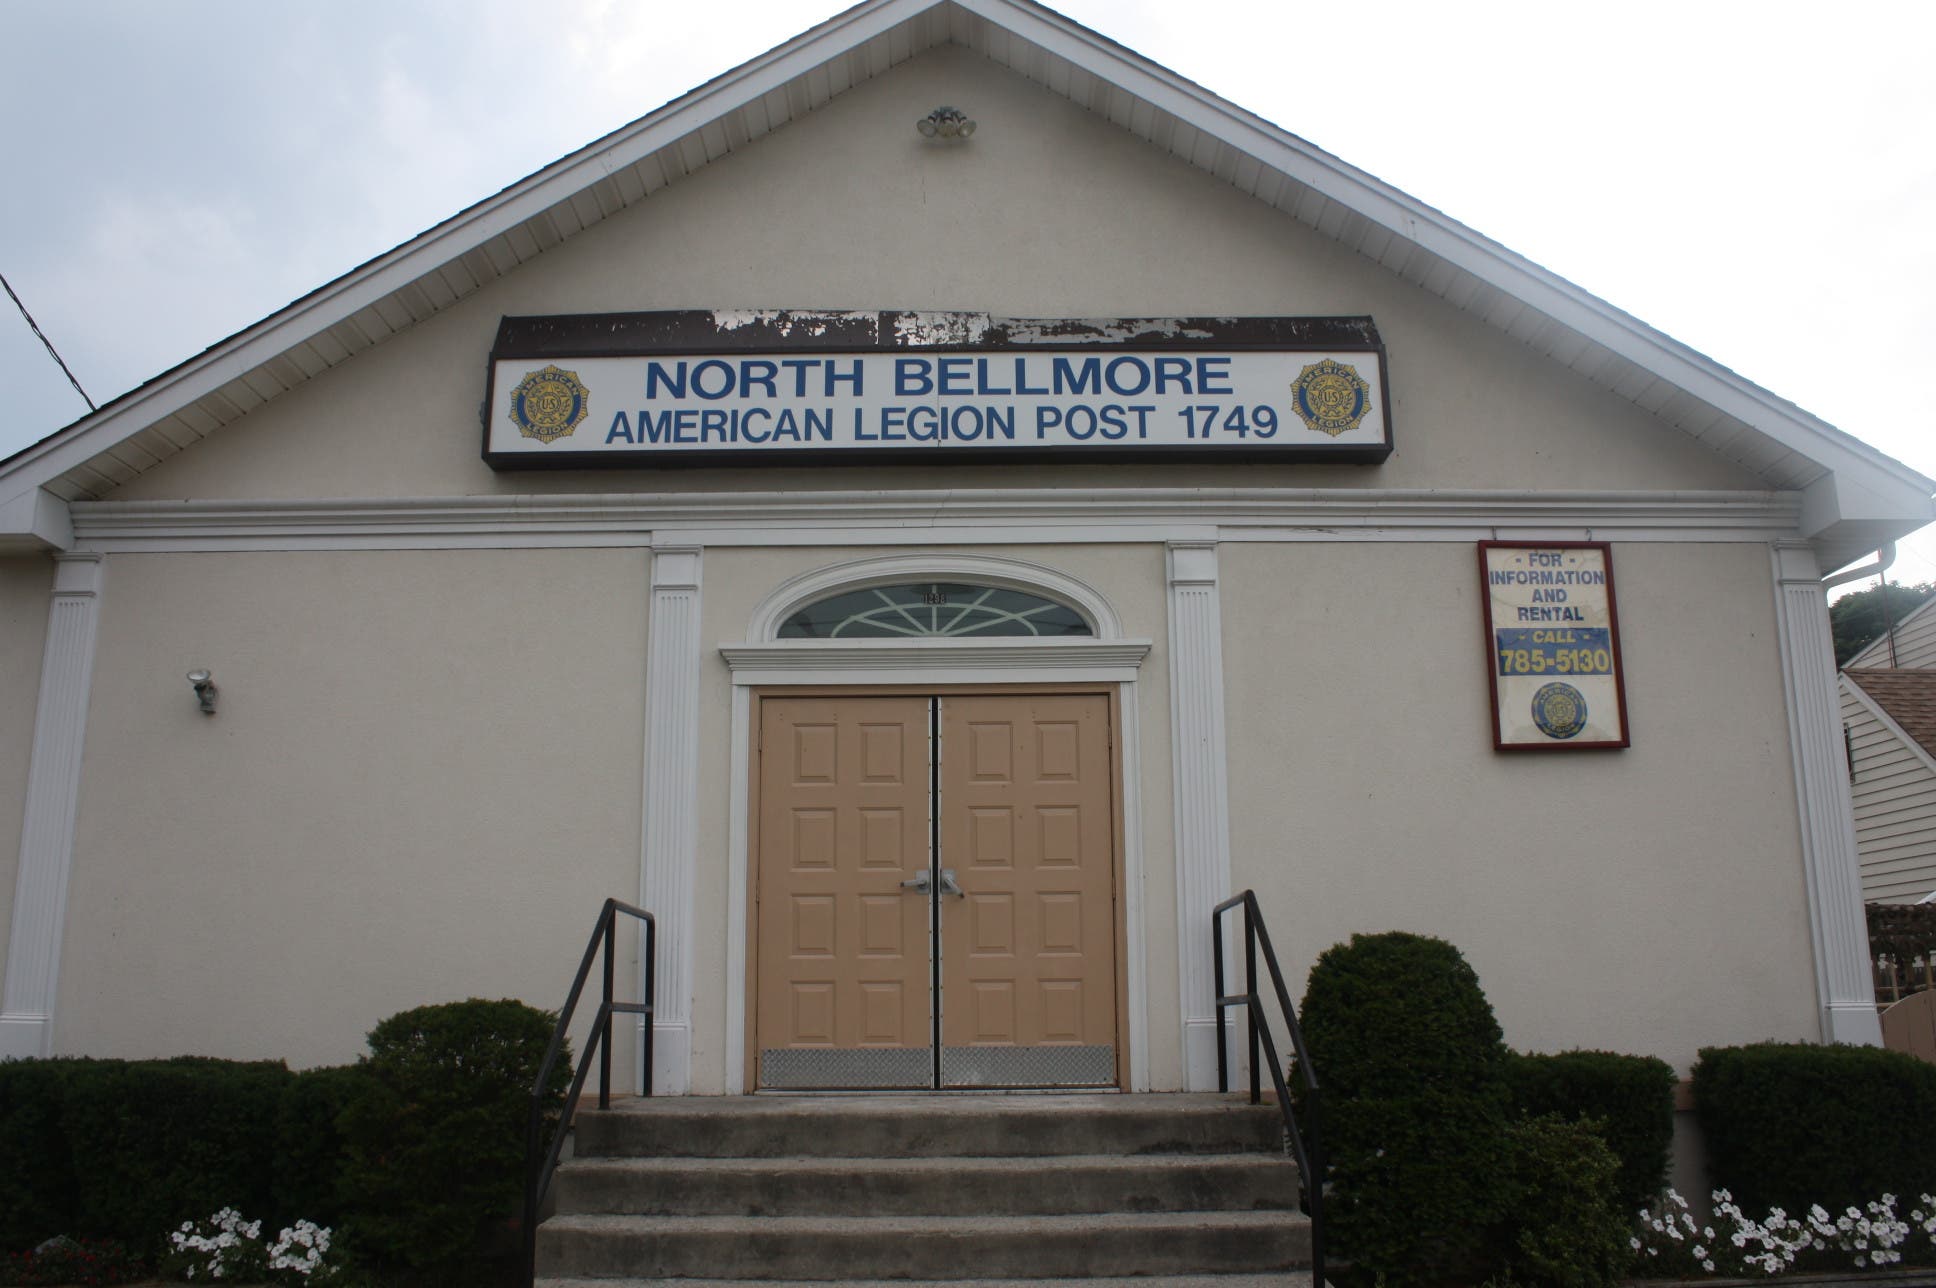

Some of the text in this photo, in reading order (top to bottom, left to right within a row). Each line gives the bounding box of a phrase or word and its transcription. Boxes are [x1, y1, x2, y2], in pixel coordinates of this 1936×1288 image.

[521, 373, 580, 396] AMERICAN
[646, 356, 1233, 399] NORTH BELLMORE
[1301, 367, 1361, 389] AMERICAN
[526, 422, 569, 435] LEGION
[605, 405, 1278, 444] AMERICAN LEGION POST 1749
[1311, 415, 1354, 428] LEGION
[1528, 553, 1563, 567] FOR
[1490, 570, 1605, 585] INFORMATION
[1531, 589, 1567, 603] AND
[1517, 607, 1584, 621] RENTAL
[1532, 631, 1576, 643] CALL
[1500, 649, 1610, 673] 785-5130
